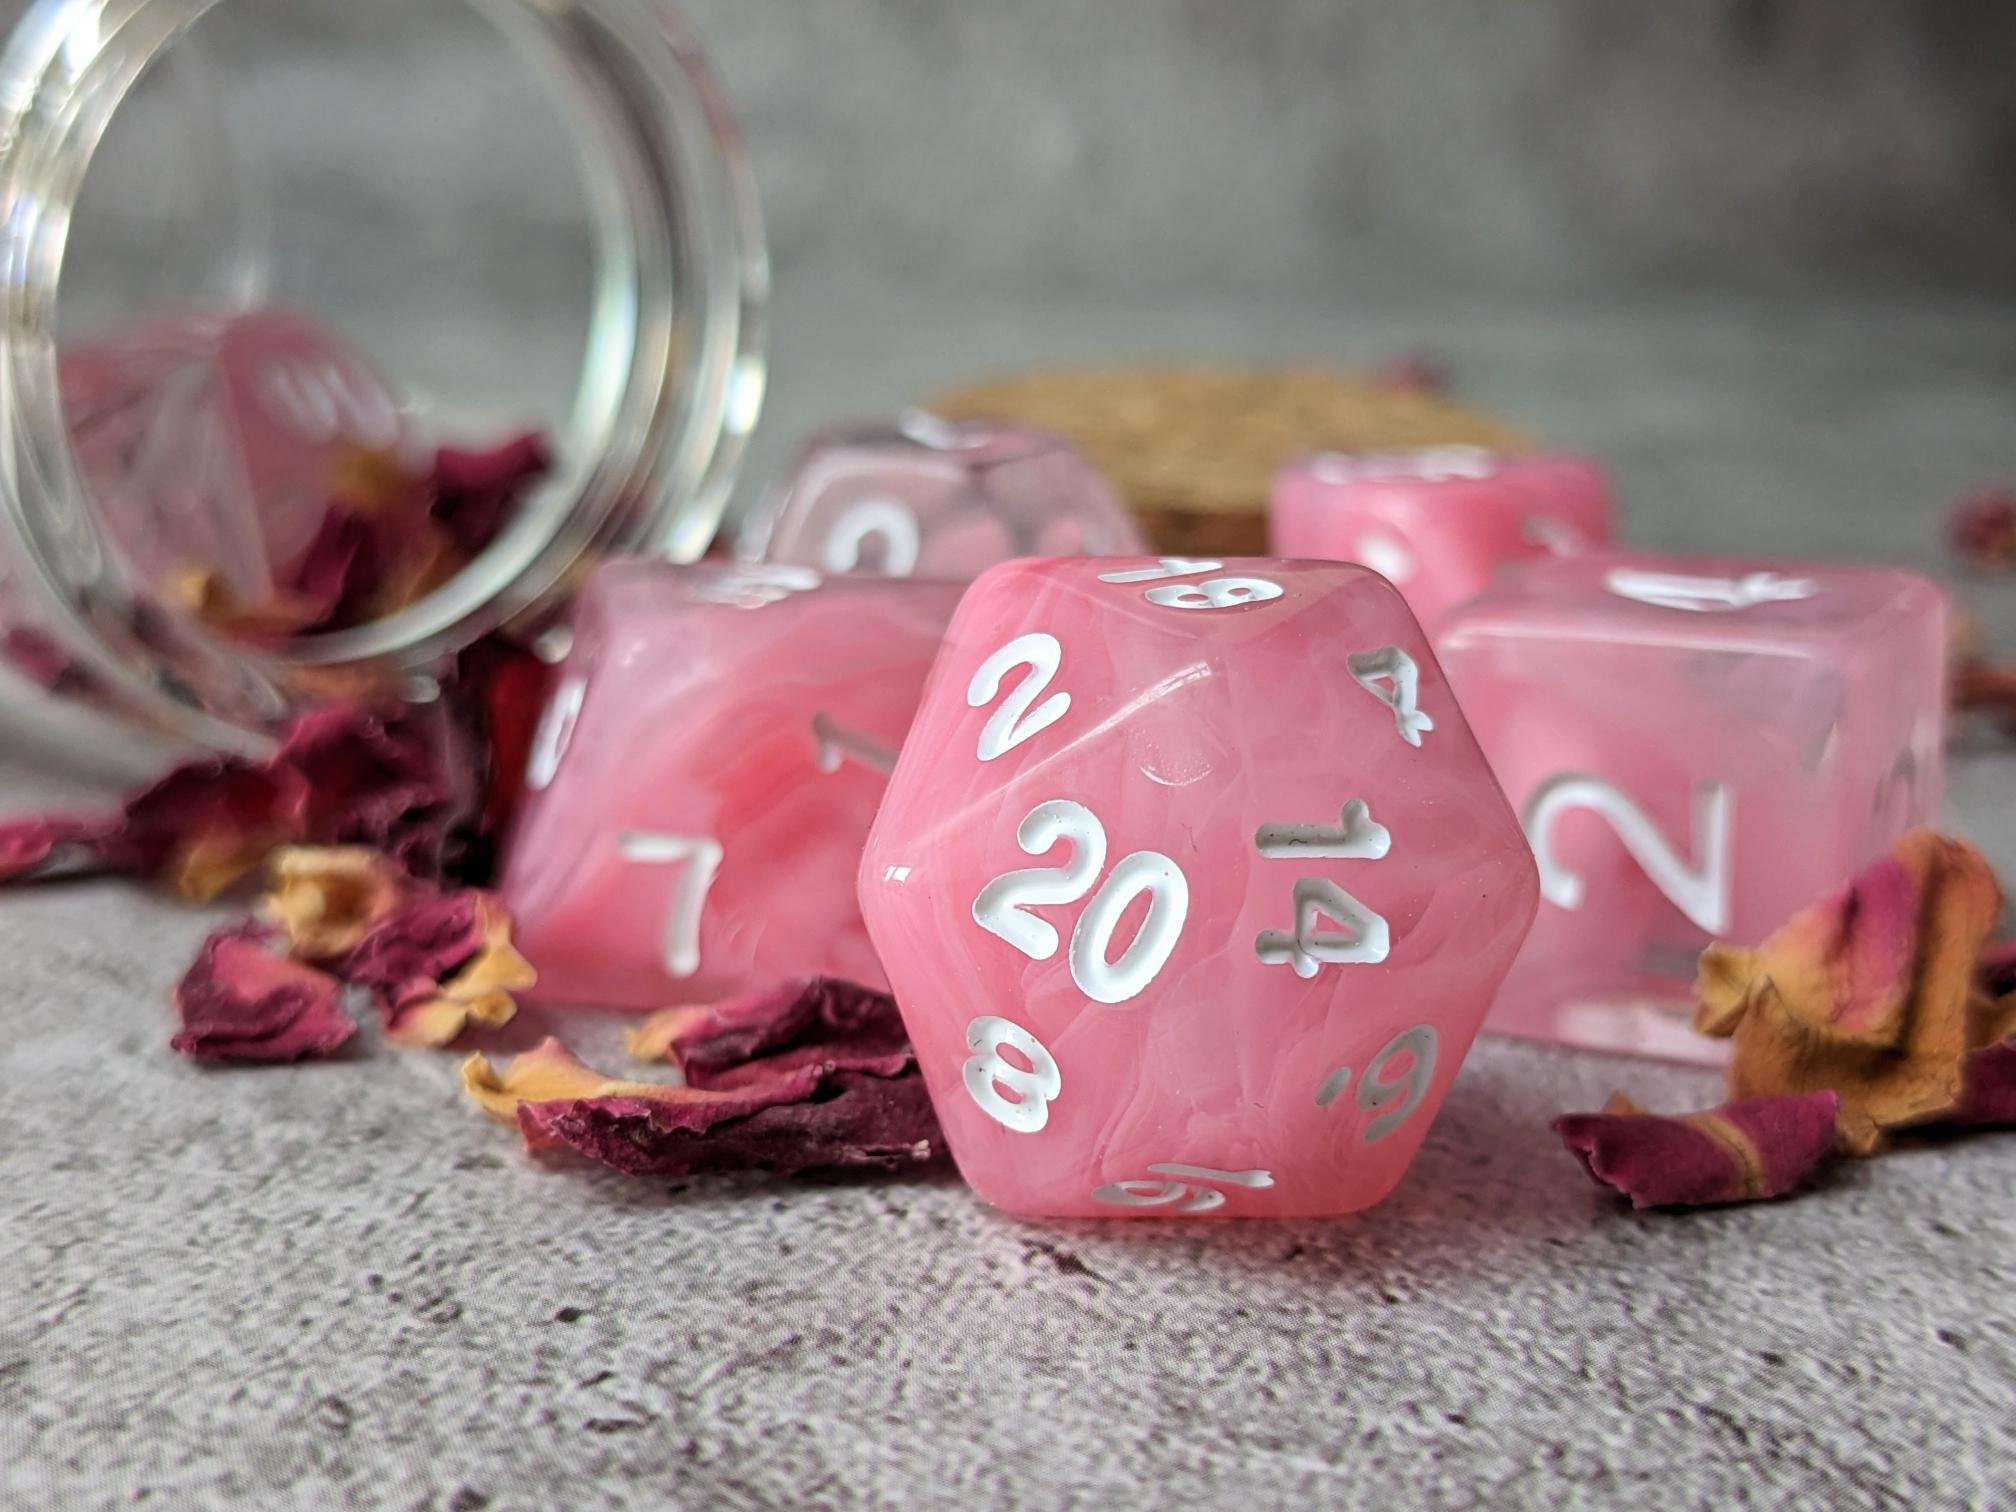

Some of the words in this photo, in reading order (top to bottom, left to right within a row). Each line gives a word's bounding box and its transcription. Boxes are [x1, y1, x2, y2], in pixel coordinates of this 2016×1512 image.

[967, 633, 1072, 762] 2
[1346, 645, 1435, 747] 4
[615, 830, 724, 978] 7
[971, 799, 1190, 1004] 20
[1254, 798, 1392, 979] 14
[1523, 772, 1729, 937] 2
[962, 1015, 1062, 1134] 8
